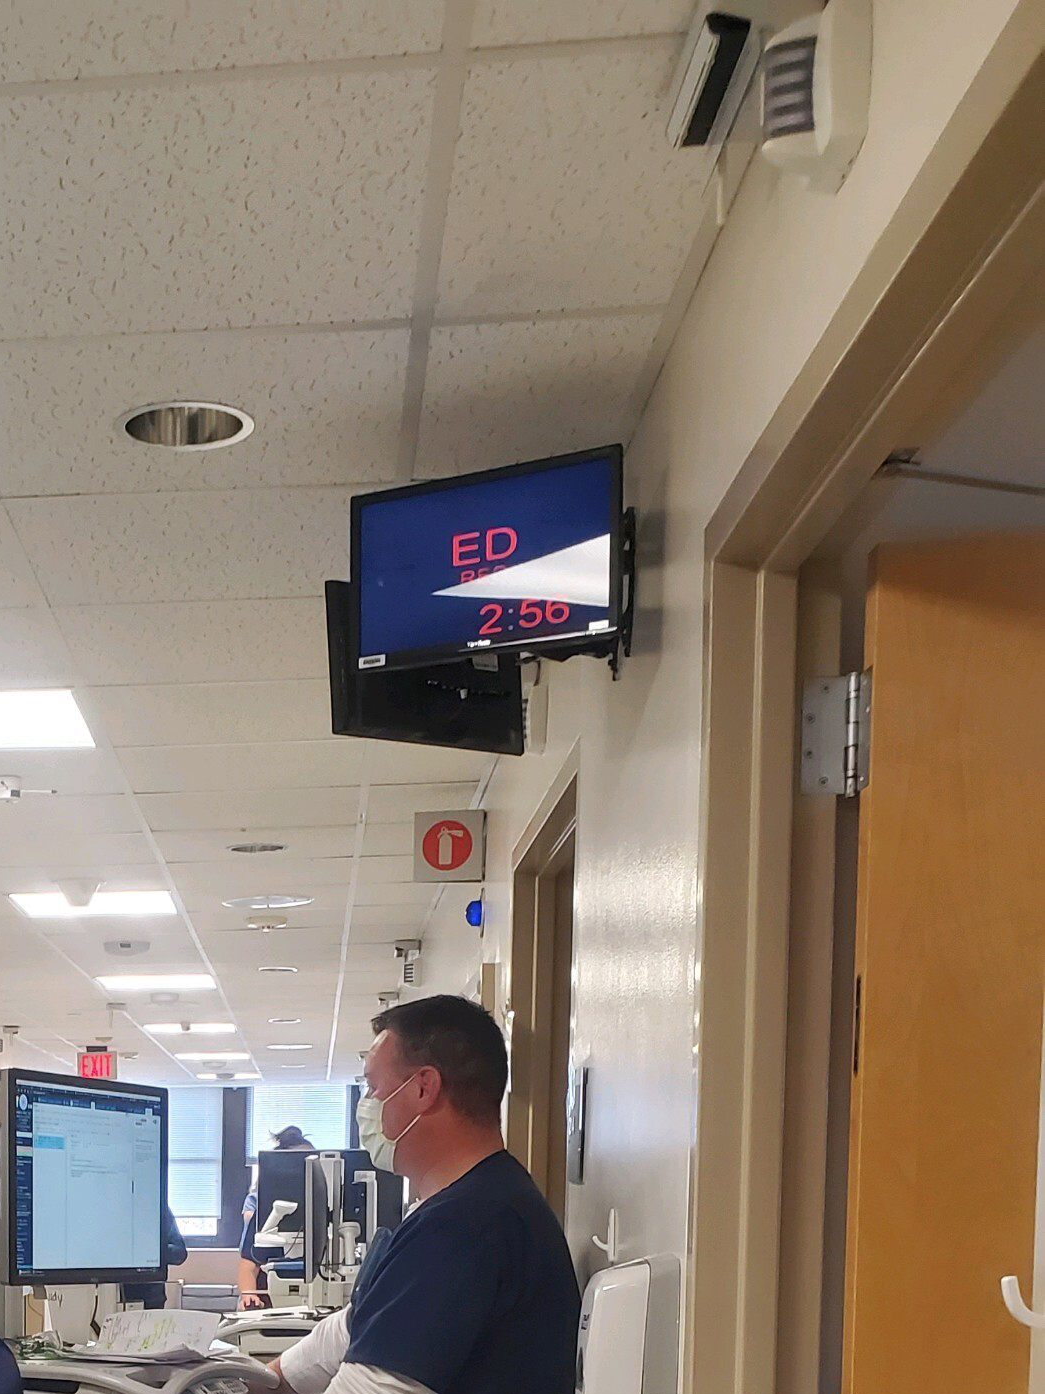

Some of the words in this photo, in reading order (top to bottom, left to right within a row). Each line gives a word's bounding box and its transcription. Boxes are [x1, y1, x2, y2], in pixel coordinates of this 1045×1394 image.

[452, 527, 517, 567] ED
[479, 595, 570, 635] 2:56
[81, 1055, 112, 1077] EXIT
